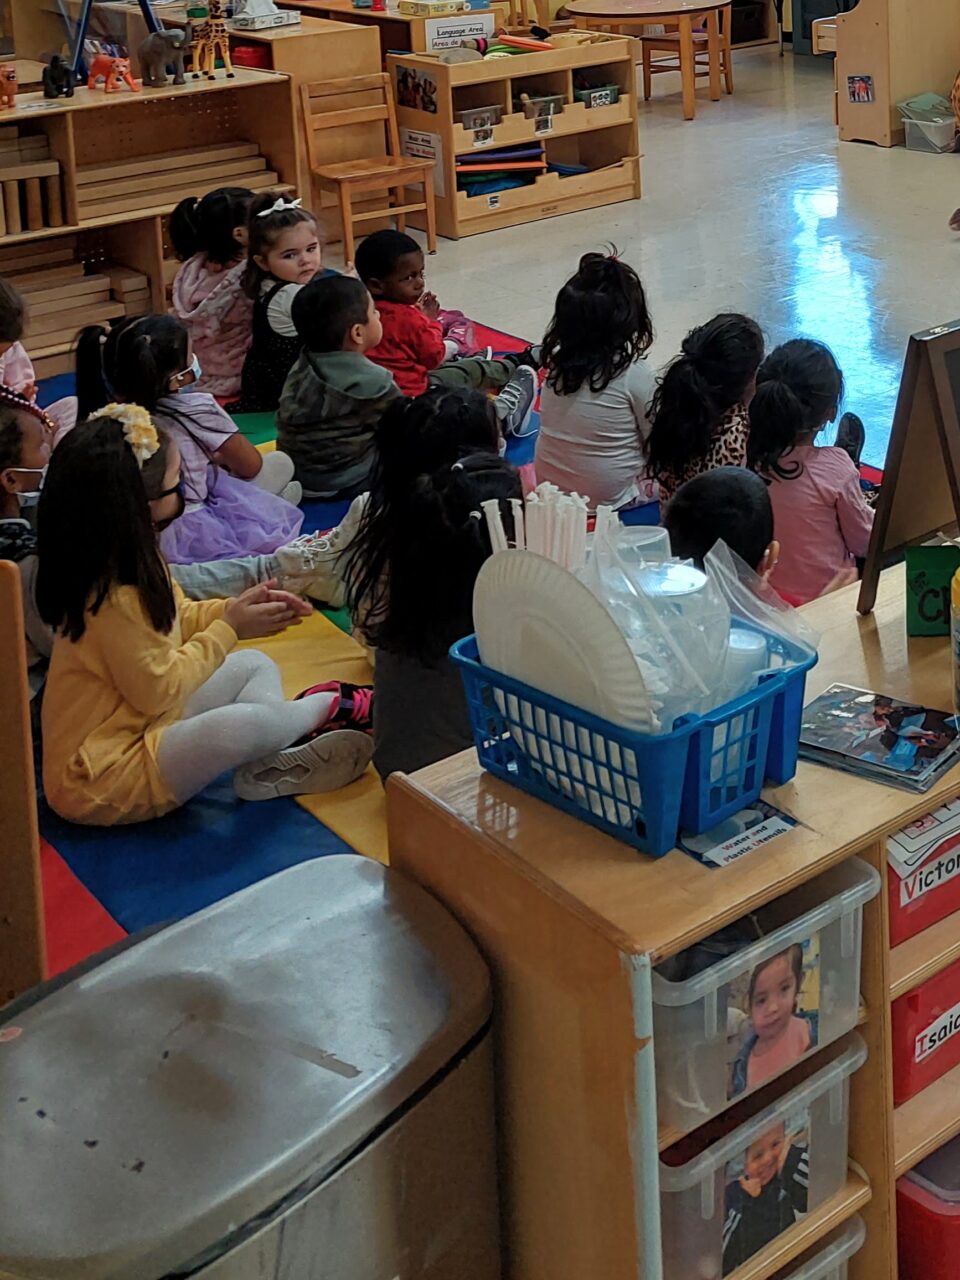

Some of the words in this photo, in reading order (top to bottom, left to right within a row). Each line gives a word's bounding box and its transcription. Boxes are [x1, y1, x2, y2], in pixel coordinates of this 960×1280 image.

[437, 28, 466, 37] Language
[722, 834, 751, 851] Water
[751, 825, 768, 836] and
[722, 845, 753, 862] Plastic
[752, 827, 788, 847] Utensils
